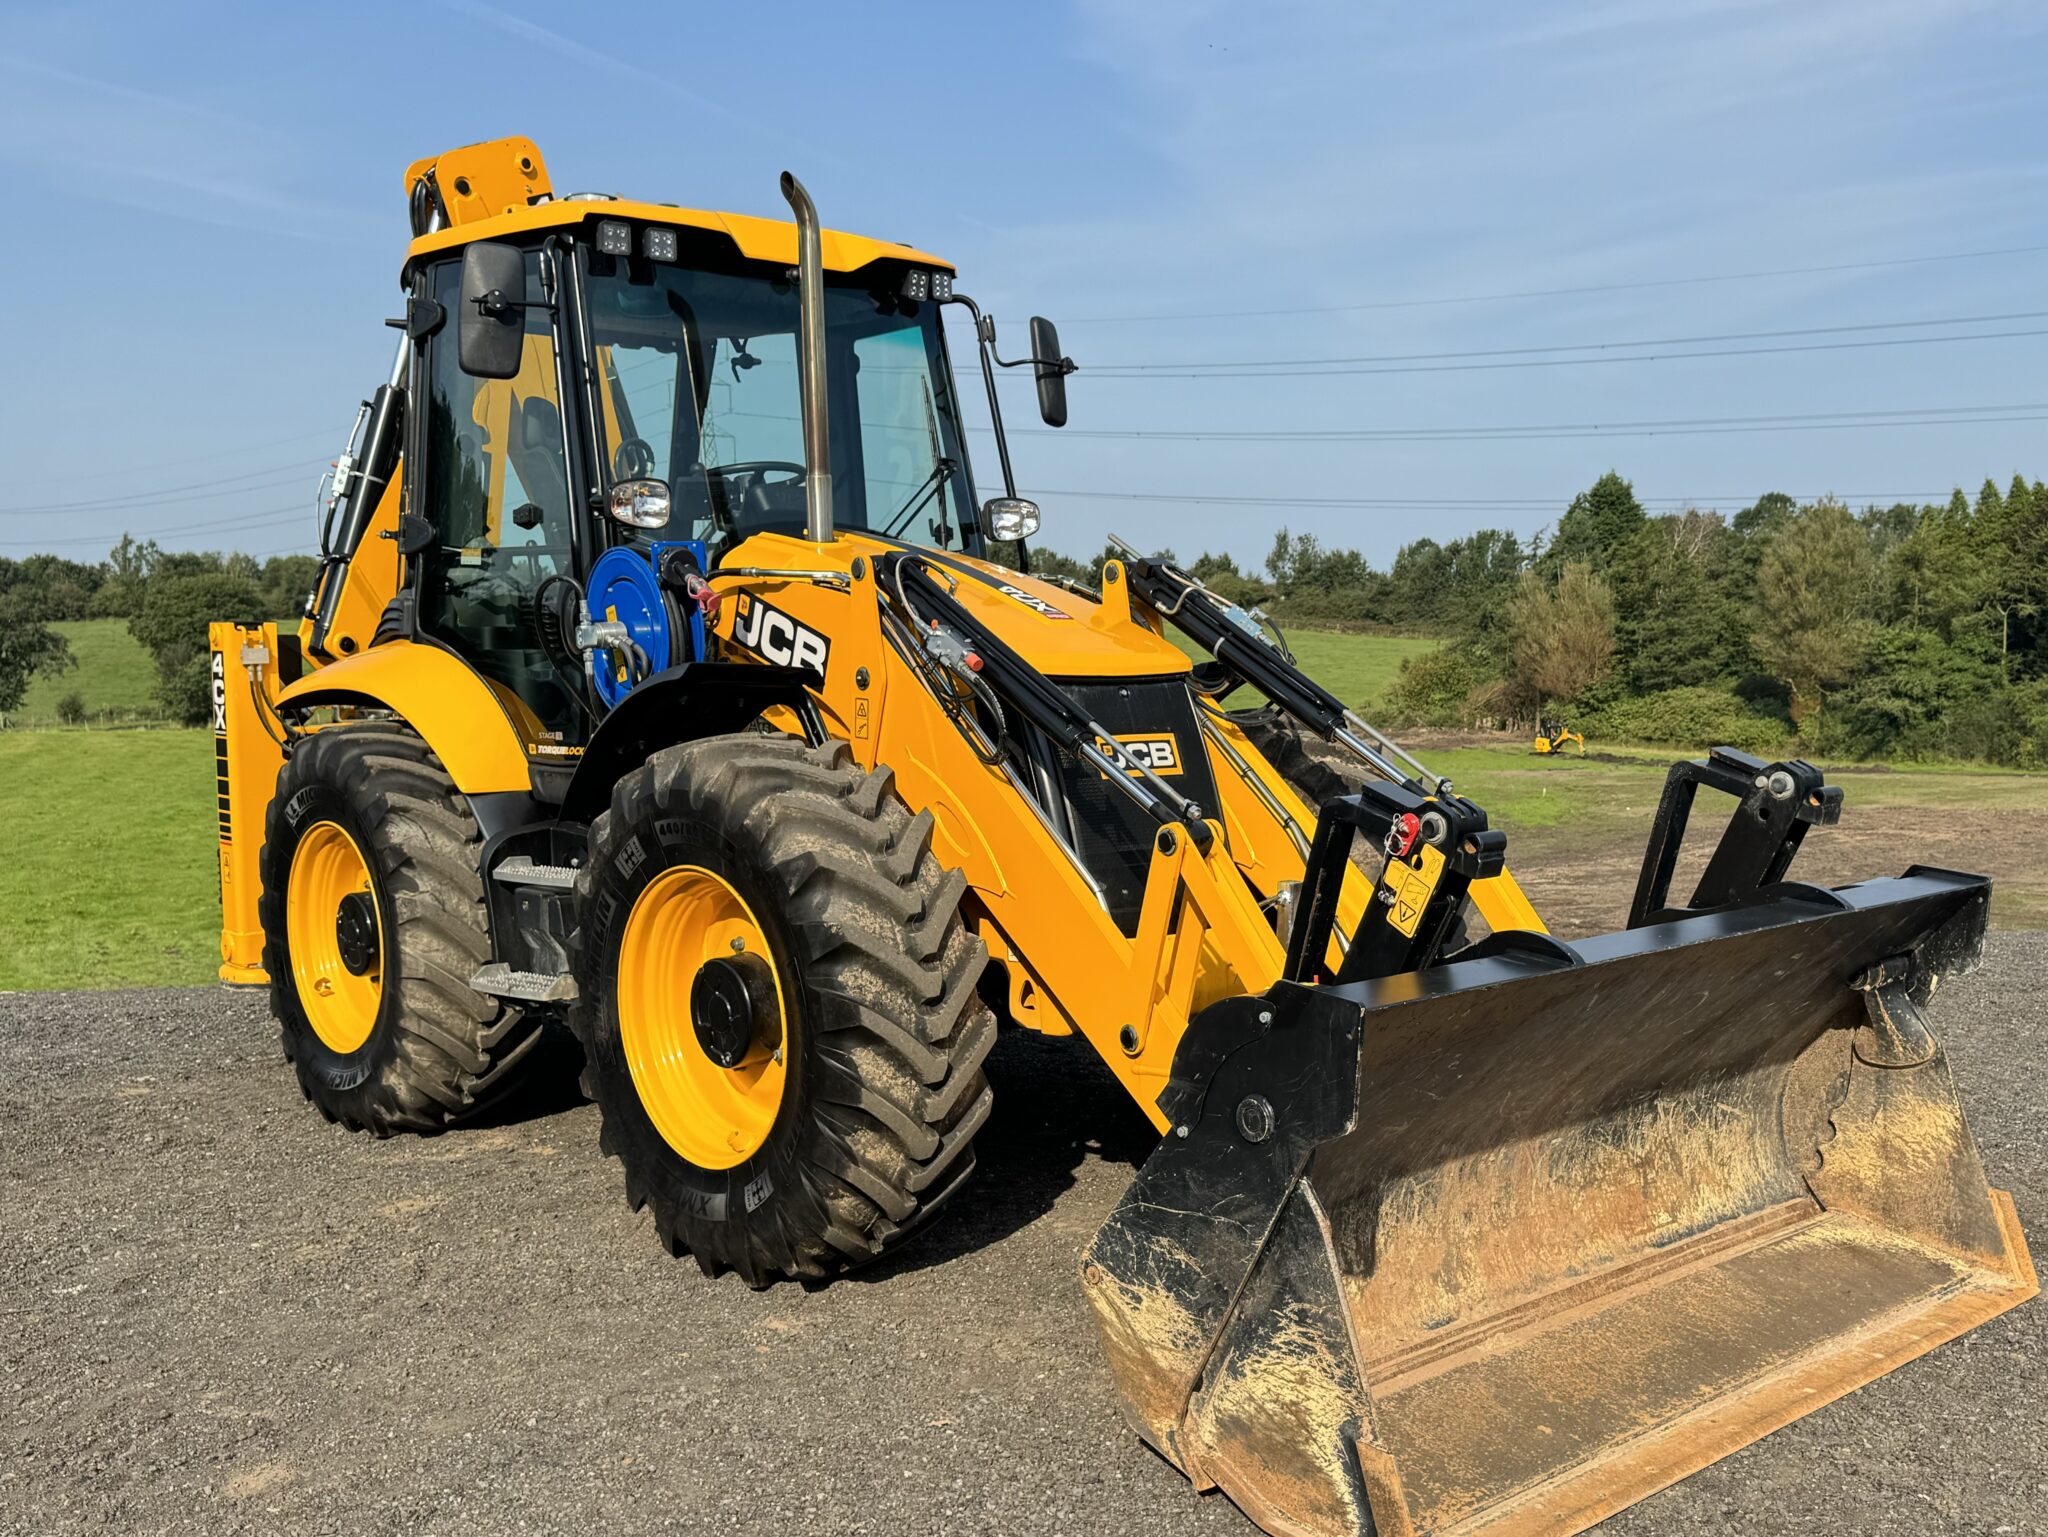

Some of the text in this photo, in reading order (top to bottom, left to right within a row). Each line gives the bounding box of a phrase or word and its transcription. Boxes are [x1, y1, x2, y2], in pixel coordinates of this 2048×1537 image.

[736, 601, 827, 677] JCB
[213, 653, 226, 729] 4CX
[538, 745, 585, 755] TORQUELOCK
